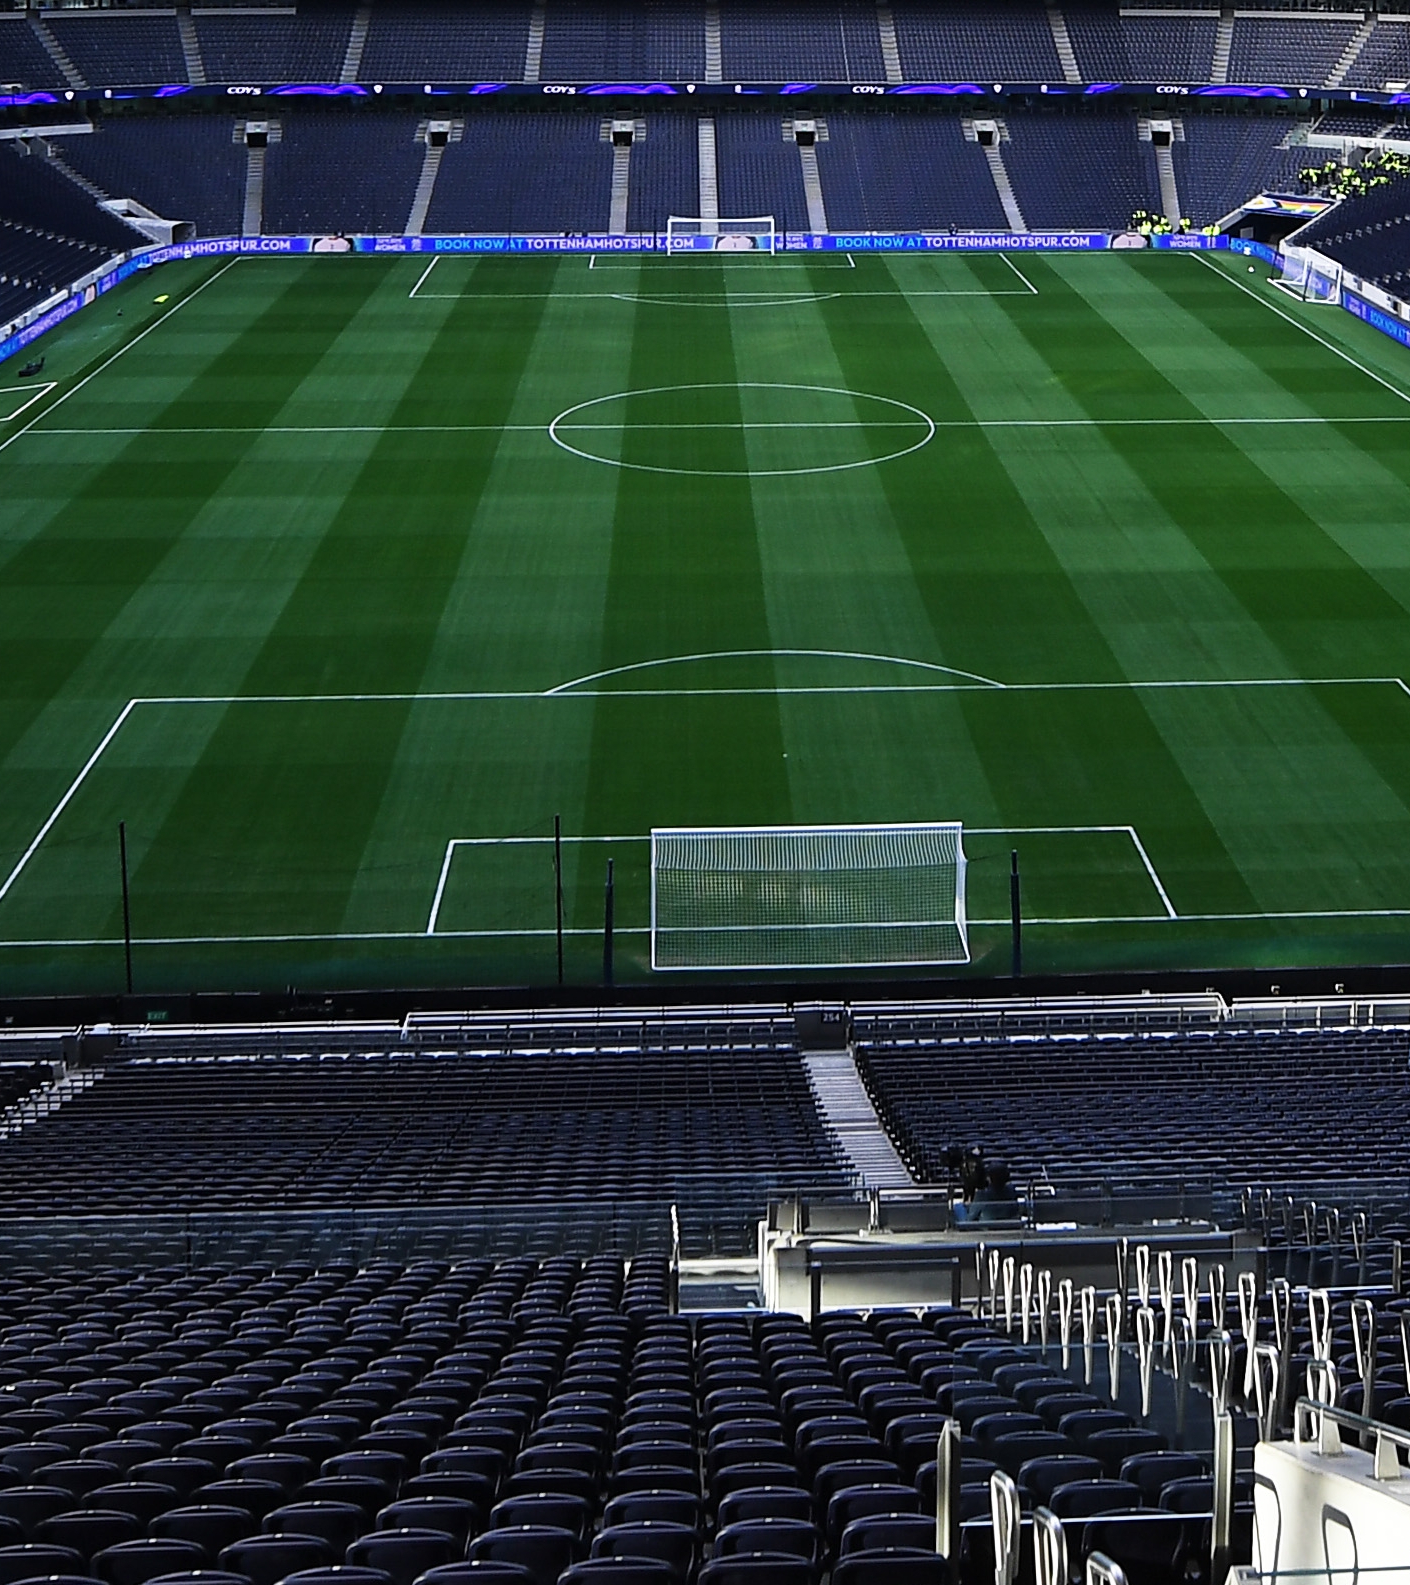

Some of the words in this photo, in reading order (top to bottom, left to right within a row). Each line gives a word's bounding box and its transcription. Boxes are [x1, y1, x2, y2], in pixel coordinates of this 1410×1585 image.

[435, 239, 472, 250] BOOK
[473, 239, 505, 250] NOW
[509, 239, 523, 250] AT
[836, 237, 871, 248] BOOK
[873, 237, 904, 248] NOW
[907, 237, 923, 248] AT
[925, 236, 1090, 248] TOTTENHAMHOTSPUR.COM
[147, 1011, 167, 1020] EXIT
[823, 1013, 840, 1022] 254
